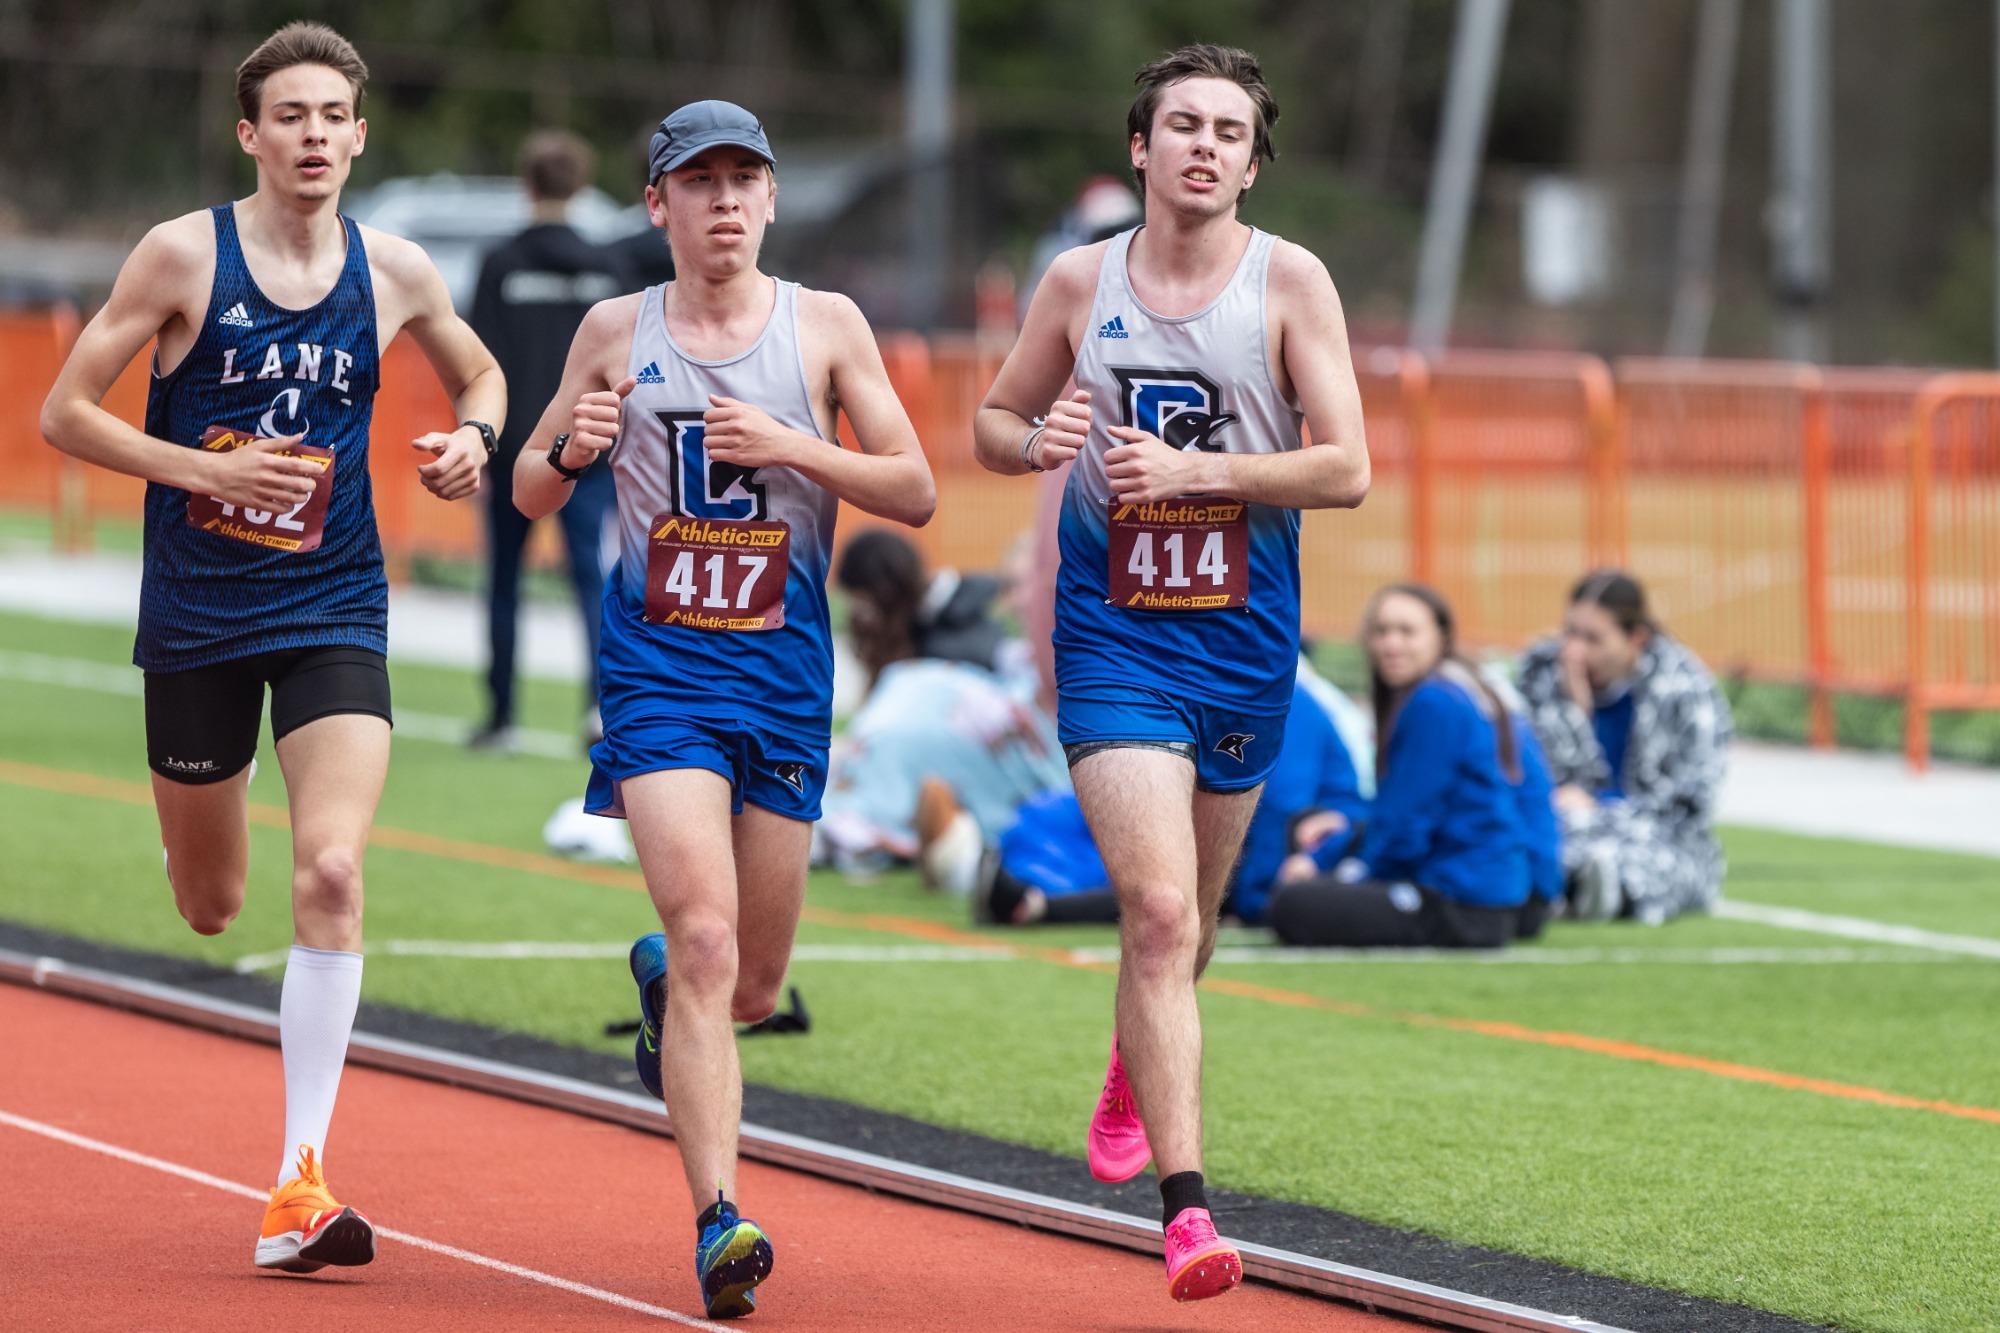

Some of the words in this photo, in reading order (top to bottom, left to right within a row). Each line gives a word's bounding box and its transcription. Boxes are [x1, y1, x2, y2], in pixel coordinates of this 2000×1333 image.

[218, 315, 254, 328] adidas
[219, 343, 353, 393] LANE
[665, 551, 768, 609] 417
[1128, 531, 1229, 587] 414
[167, 756, 213, 770] LANE
